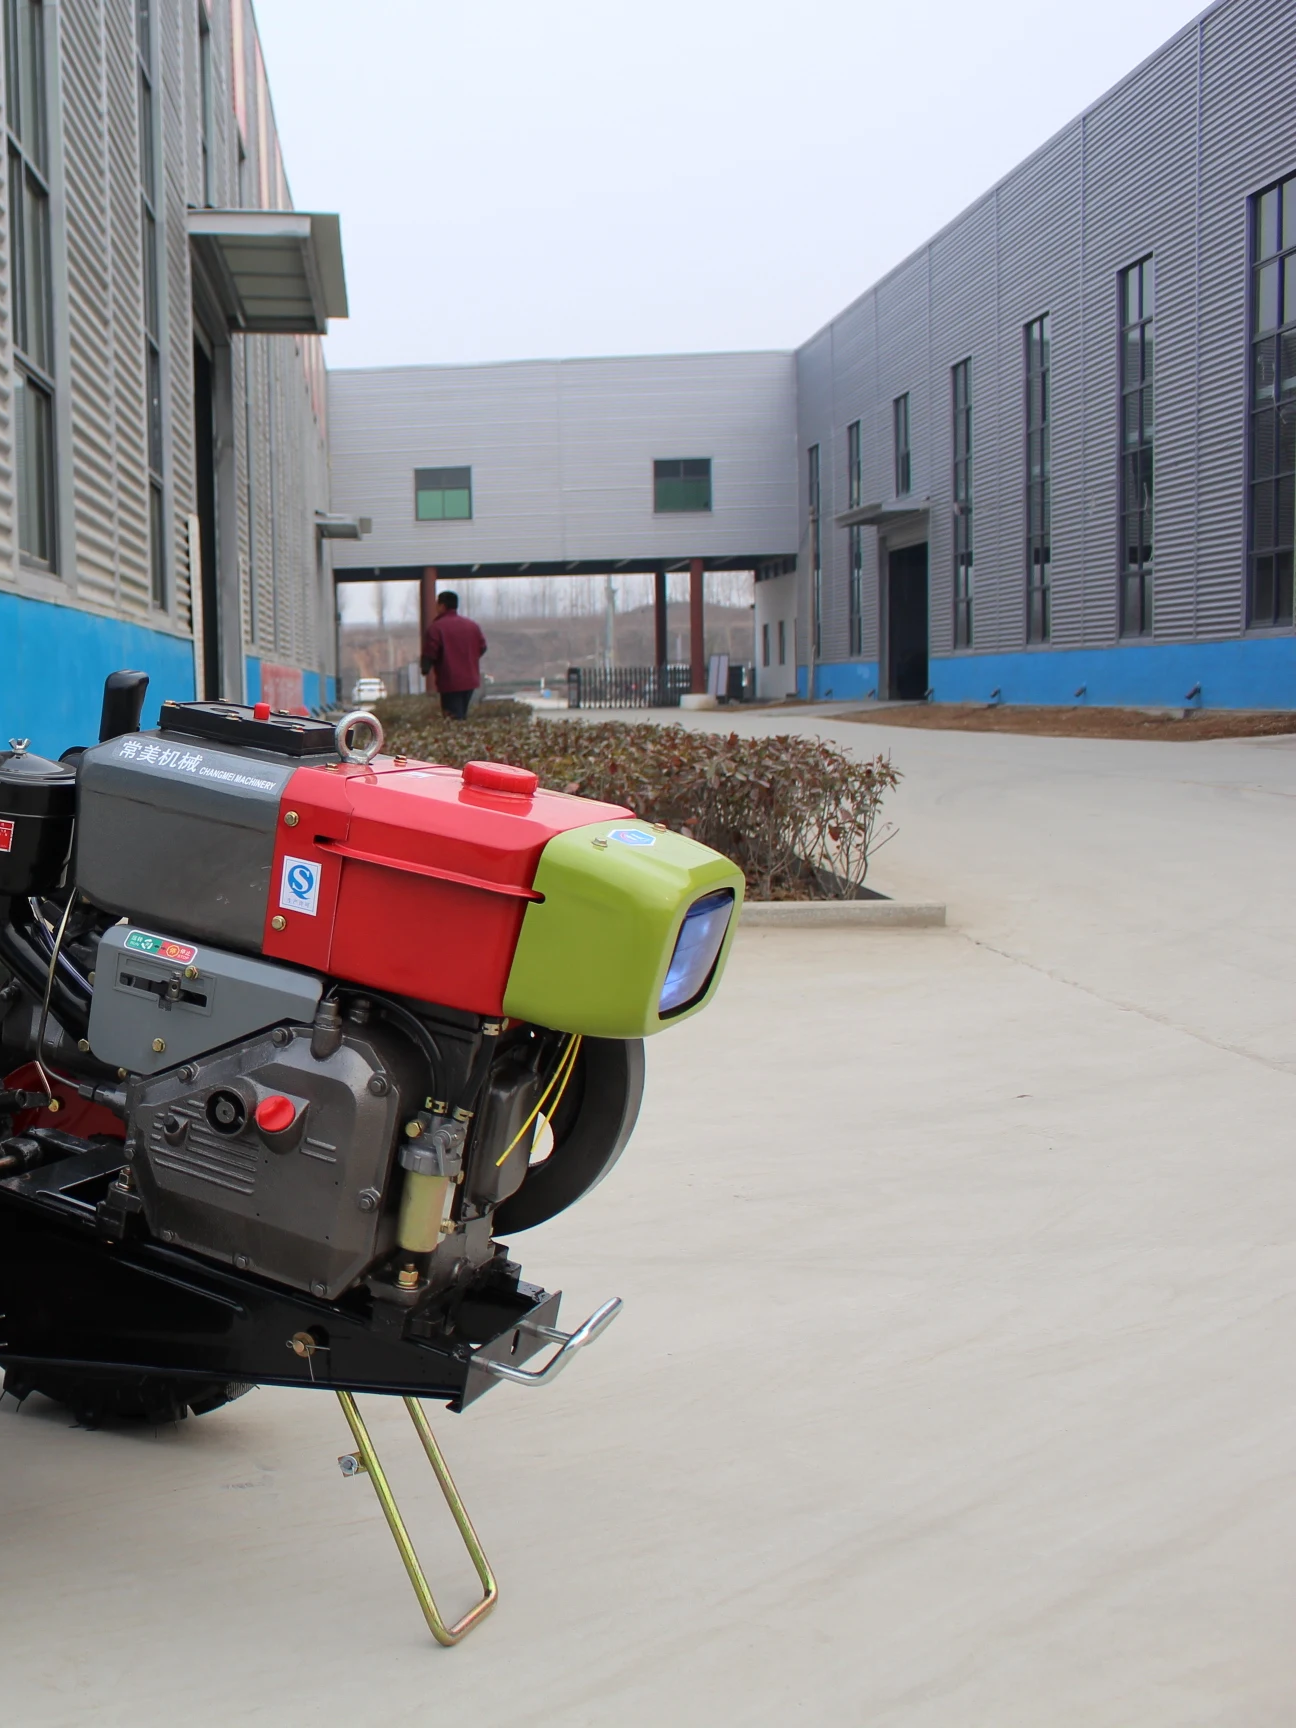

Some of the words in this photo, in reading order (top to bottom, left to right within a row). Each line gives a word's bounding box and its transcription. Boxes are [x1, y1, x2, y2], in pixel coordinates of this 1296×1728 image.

[118, 740, 203, 773] 常美机械
[198, 766, 236, 781] CHANGMEI
[235, 774, 276, 791] MACHINERY
